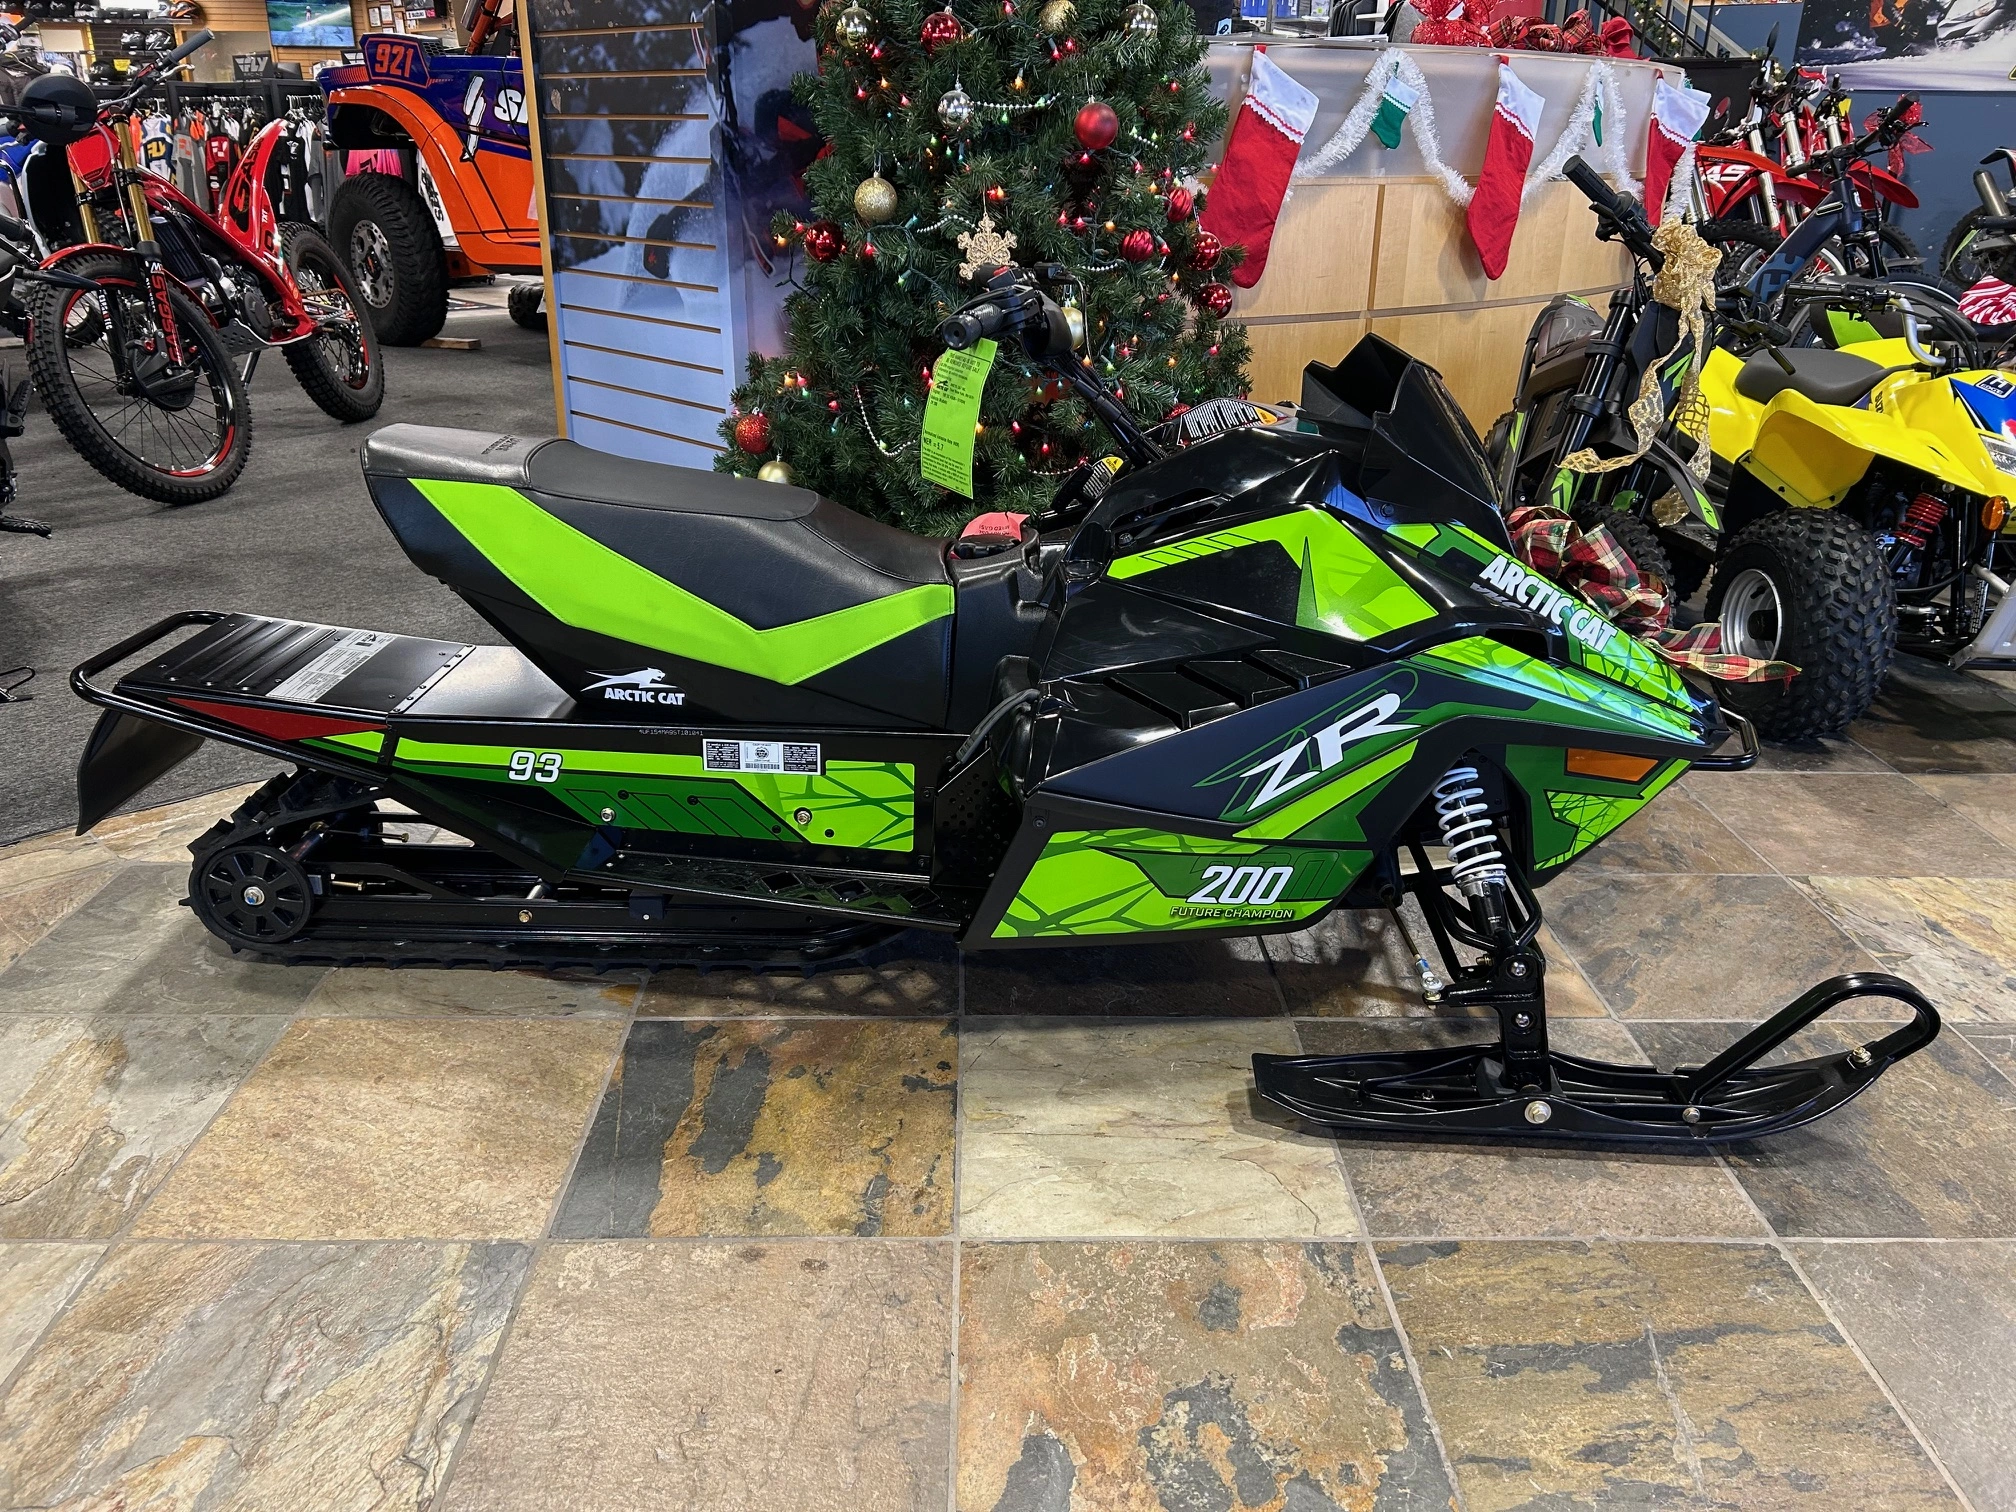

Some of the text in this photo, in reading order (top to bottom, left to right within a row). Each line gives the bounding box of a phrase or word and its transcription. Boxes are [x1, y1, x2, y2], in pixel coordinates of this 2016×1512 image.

[234, 56, 269, 72] FLY
[374, 43, 414, 78] 921
[151, 274, 183, 362] GASGAS
[1479, 554, 1619, 653] ARCTIC CAT
[604, 687, 687, 706] ARCTIC CAT
[508, 750, 564, 784] 93
[1239, 692, 1422, 813] ZR
[1186, 865, 1295, 905] 200
[1170, 906, 1294, 919] FUTURE CHAMPION
